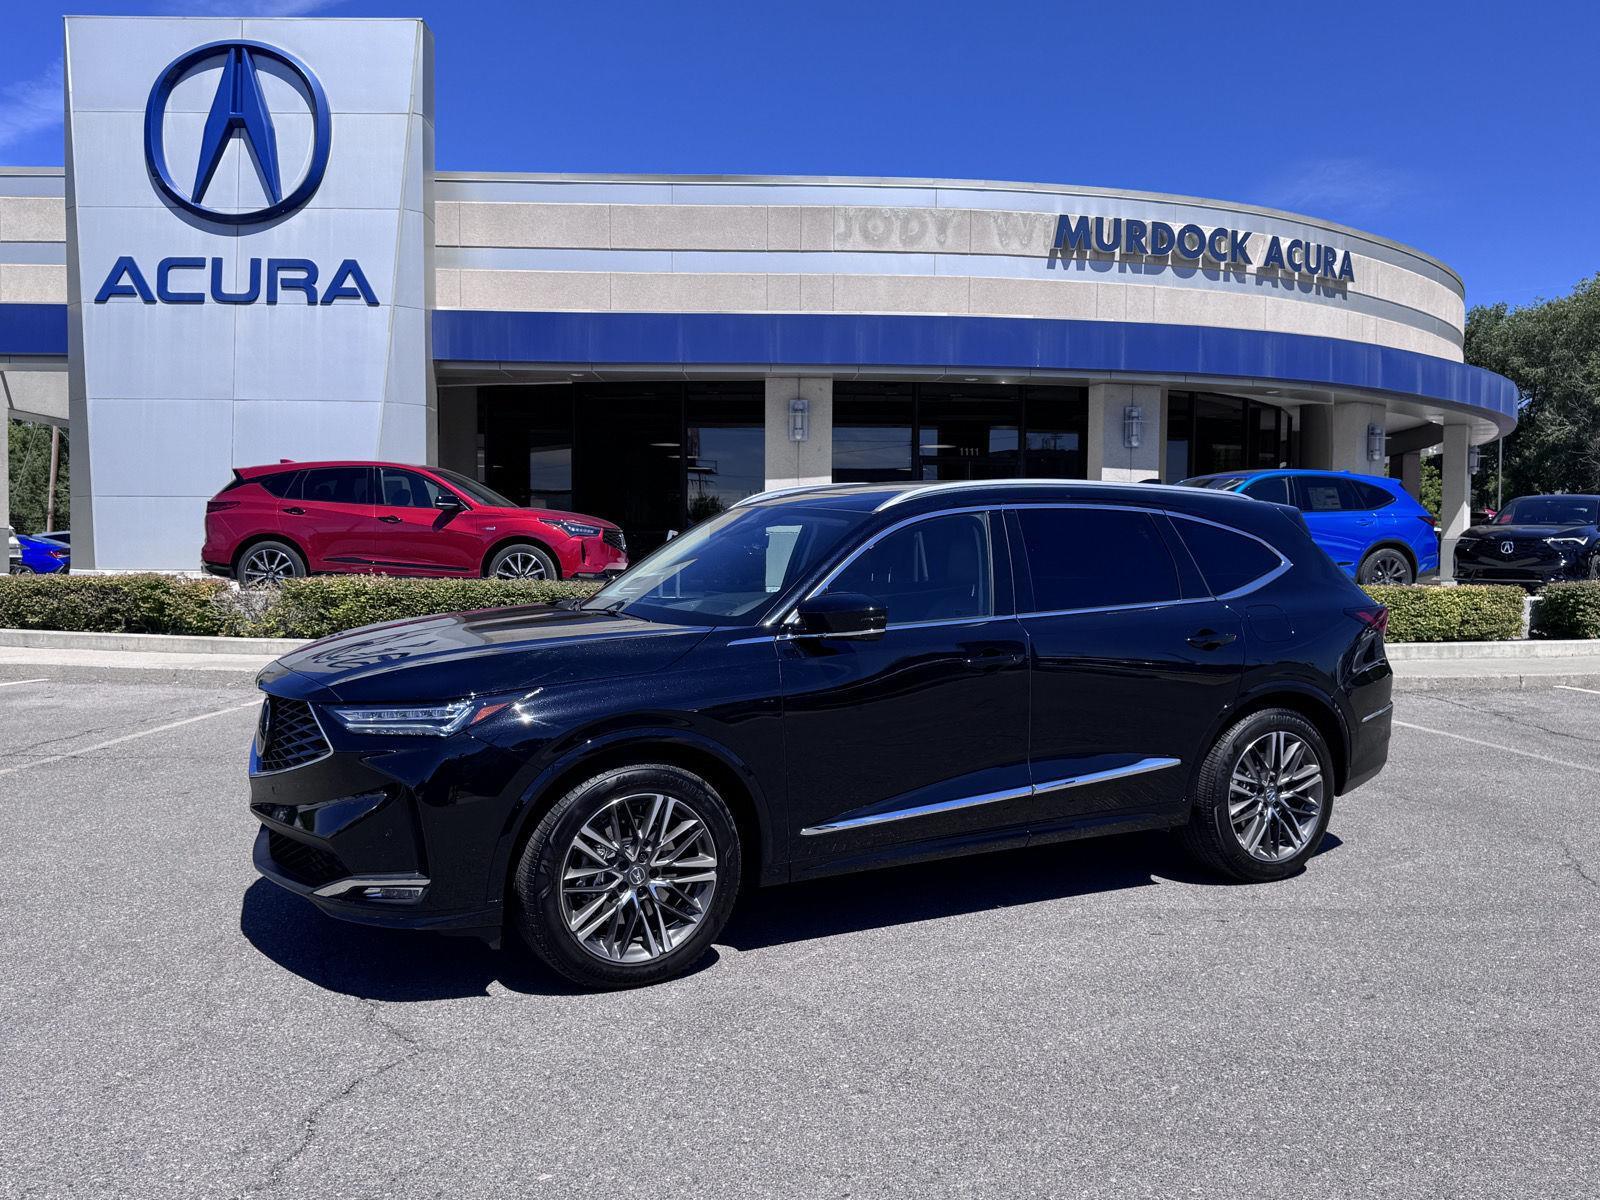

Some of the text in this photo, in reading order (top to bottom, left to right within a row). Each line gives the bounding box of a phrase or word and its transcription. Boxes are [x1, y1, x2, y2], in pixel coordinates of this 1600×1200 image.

[1052, 214, 1355, 284] MURDOCK ACURA
[94, 256, 380, 307] ACURA
